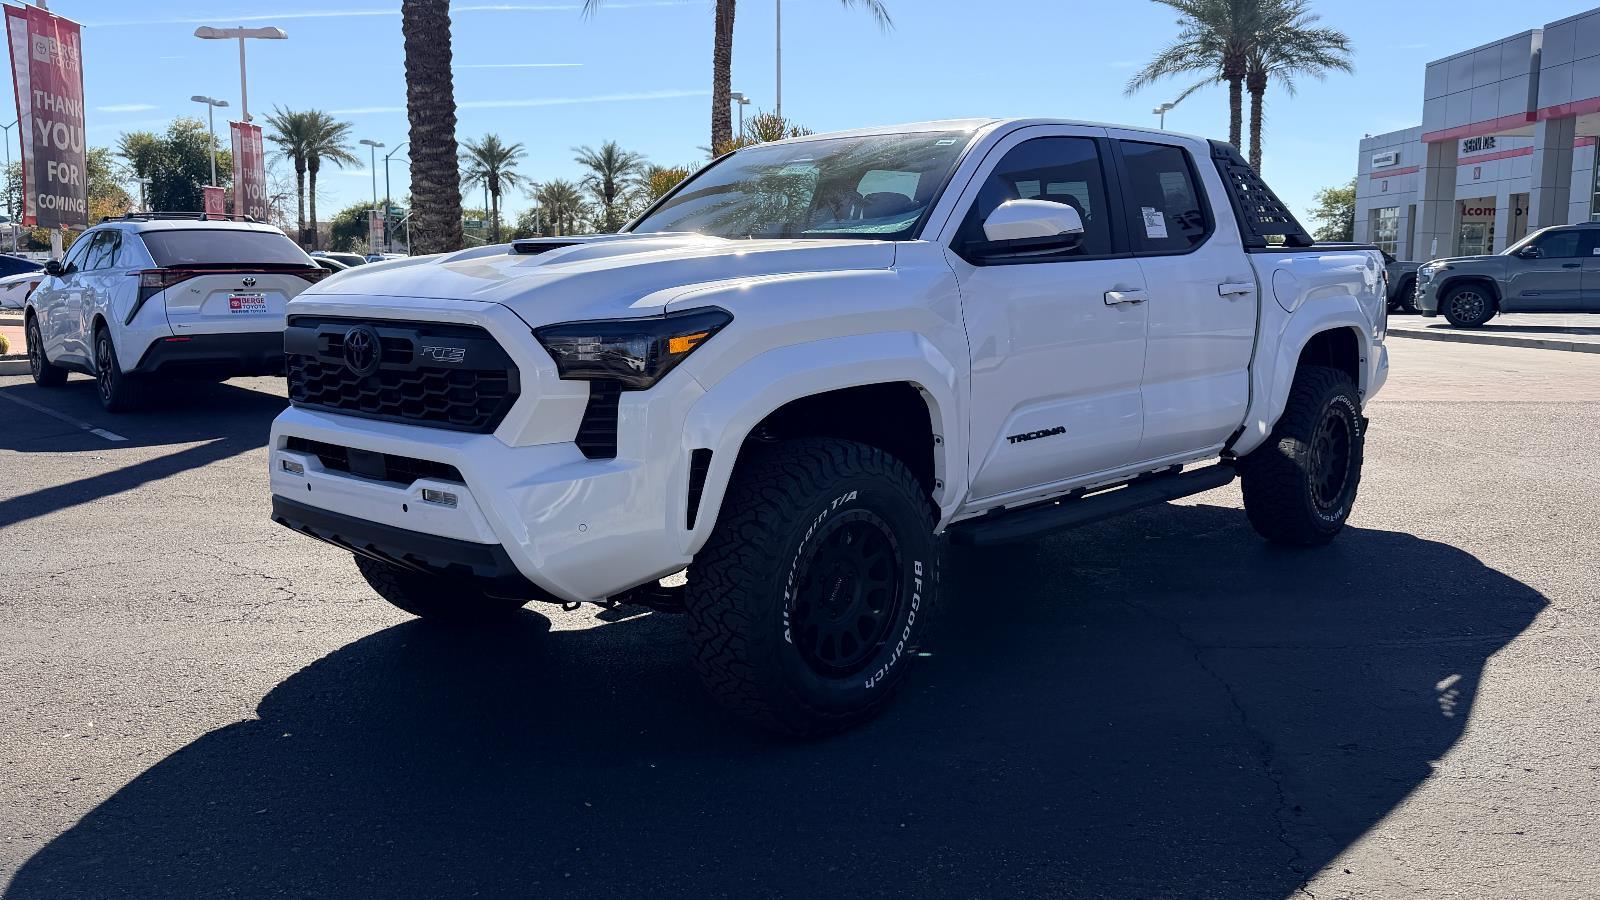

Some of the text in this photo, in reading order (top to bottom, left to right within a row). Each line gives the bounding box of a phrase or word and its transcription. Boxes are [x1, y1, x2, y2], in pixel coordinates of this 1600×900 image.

[33, 89, 82, 118] THANK
[36, 117, 83, 154] YOU
[47, 160, 80, 186] FOR
[38, 192, 86, 215] COMING!
[245, 184, 265, 201] YOU
[249, 206, 264, 219] FOR
[1006, 425, 1067, 445] TACOMA
[783, 490, 858, 644] All-Terrain T/A
[864, 560, 923, 689] BFGoodrich
